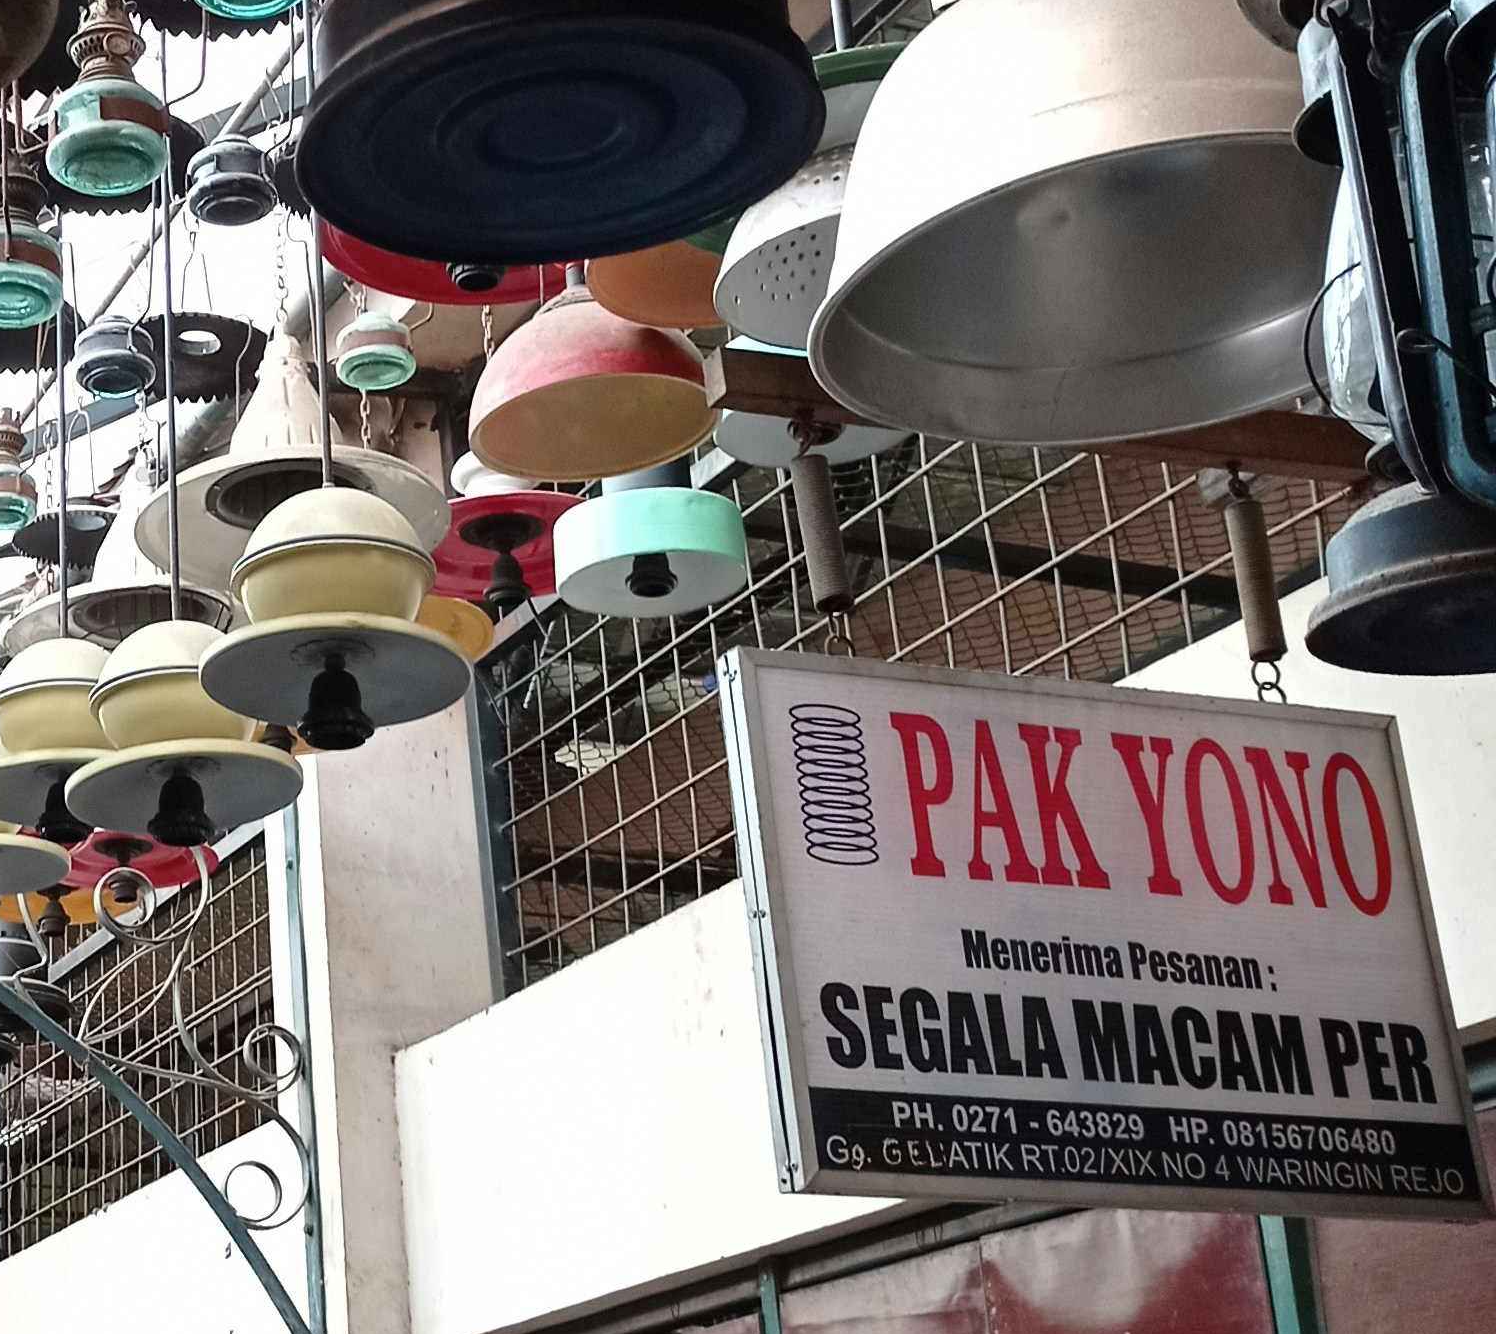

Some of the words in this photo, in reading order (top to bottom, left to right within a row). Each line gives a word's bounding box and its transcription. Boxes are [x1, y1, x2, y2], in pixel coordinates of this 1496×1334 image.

[890, 711, 1110, 890] PAK
[1112, 733, 1392, 917] YONO
[961, 928, 1123, 979] Menerima
[1127, 940, 1260, 990] Pesanan
[819, 981, 1067, 1078] SEGALA
[1072, 997, 1314, 1096] MACAM
[1318, 1016, 1437, 1104] PER
[891, 1101, 944, 1133] PH.
[951, 1103, 1017, 1134] 0271
[1045, 1109, 1144, 1140] 643829
[1169, 1116, 1215, 1144] HP.
[1223, 1119, 1396, 1156] 08156706480
[1022, 1142, 1158, 1179] RT.02/XIX
[1162, 1151, 1206, 1180] NO
[1215, 1155, 1231, 1182] 4
[1237, 1156, 1385, 1190] WARINGIN
[1391, 1166, 1465, 1195] REJO
